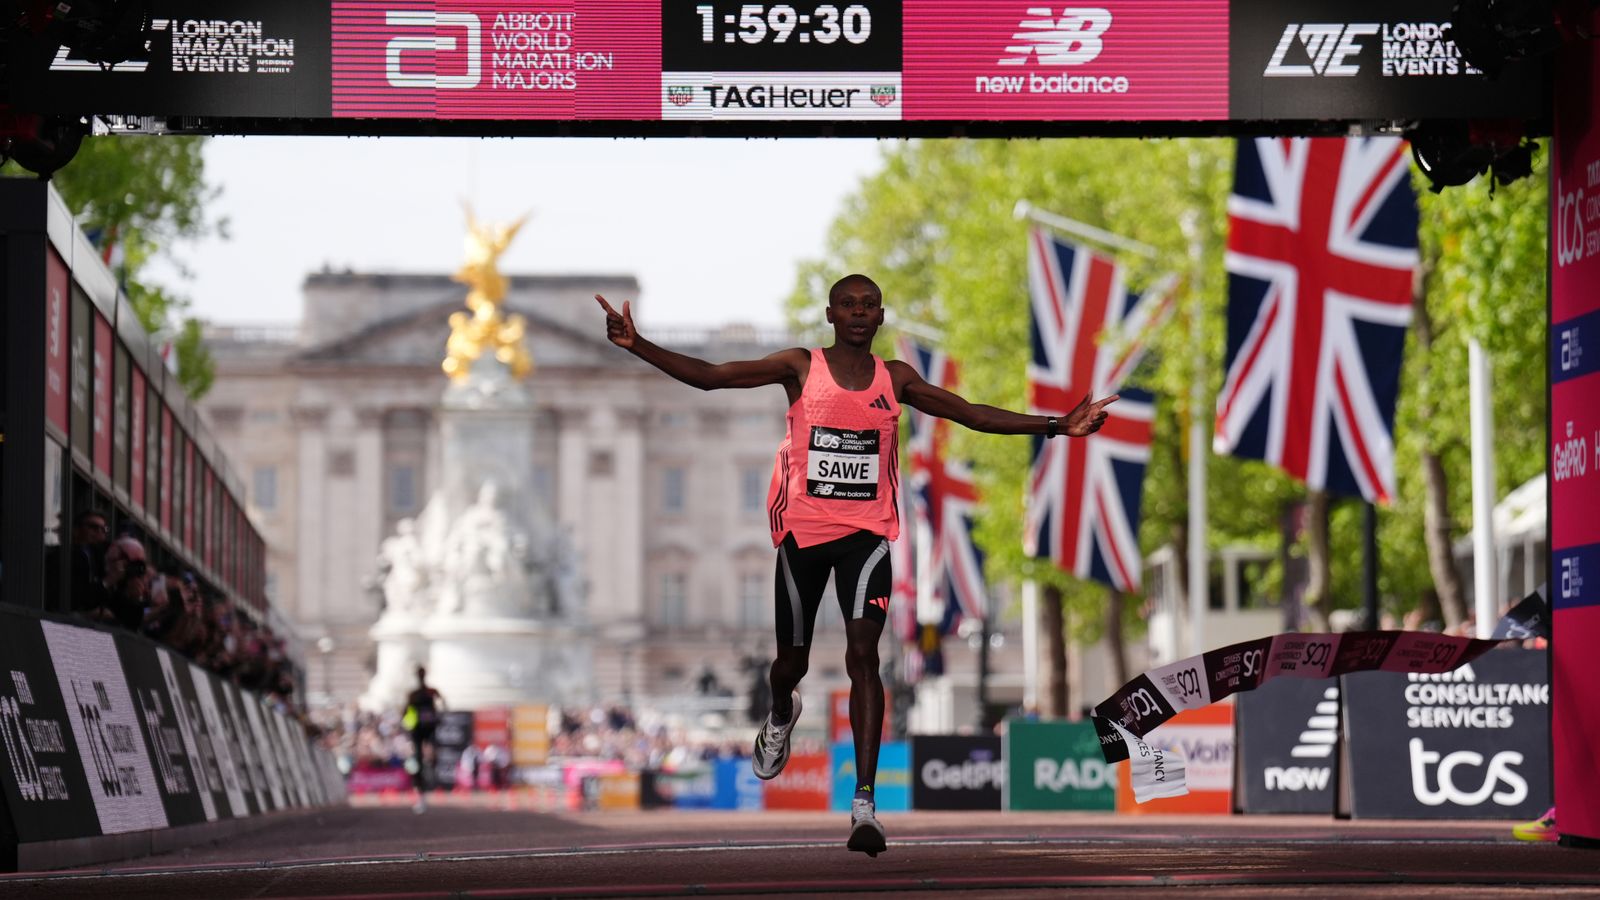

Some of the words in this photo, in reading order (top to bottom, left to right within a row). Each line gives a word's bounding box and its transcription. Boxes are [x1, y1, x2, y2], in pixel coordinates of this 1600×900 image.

[172, 20, 262, 38] LONDON
[492, 12, 575, 31] ABBOTT
[696, 4, 872, 45] 1:59:30
[1382, 22, 1453, 42] LOND
[172, 38, 294, 56] MARATHON
[491, 32, 572, 51] WORLD
[1382, 40, 1462, 58] MARAT
[172, 56, 250, 73] EVENTS
[492, 52, 613, 70] MARATHON
[1382, 58, 1459, 76] EVENTS
[491, 71, 577, 90] MAJORS
[975, 75, 1025, 93] new
[1029, 71, 1129, 93] balance
[1558, 178, 1584, 268] tcs
[814, 430, 840, 449] tcs
[818, 460, 870, 480] SAWE
[1243, 649, 1264, 678] cs
[1302, 642, 1332, 673] tcs
[10, 670, 35, 705] TATA
[1177, 667, 1202, 699] tcs
[1405, 683, 1549, 705] CONSULTANC
[1126, 687, 1163, 721] tcs
[1407, 706, 1514, 728] SERVICES
[26, 717, 66, 753] CONSULTANCY
[71, 679, 122, 797] tcs
[1264, 766, 1331, 792] new
[1409, 737, 1529, 806] tcs
[40, 766, 69, 800] SERVICES
